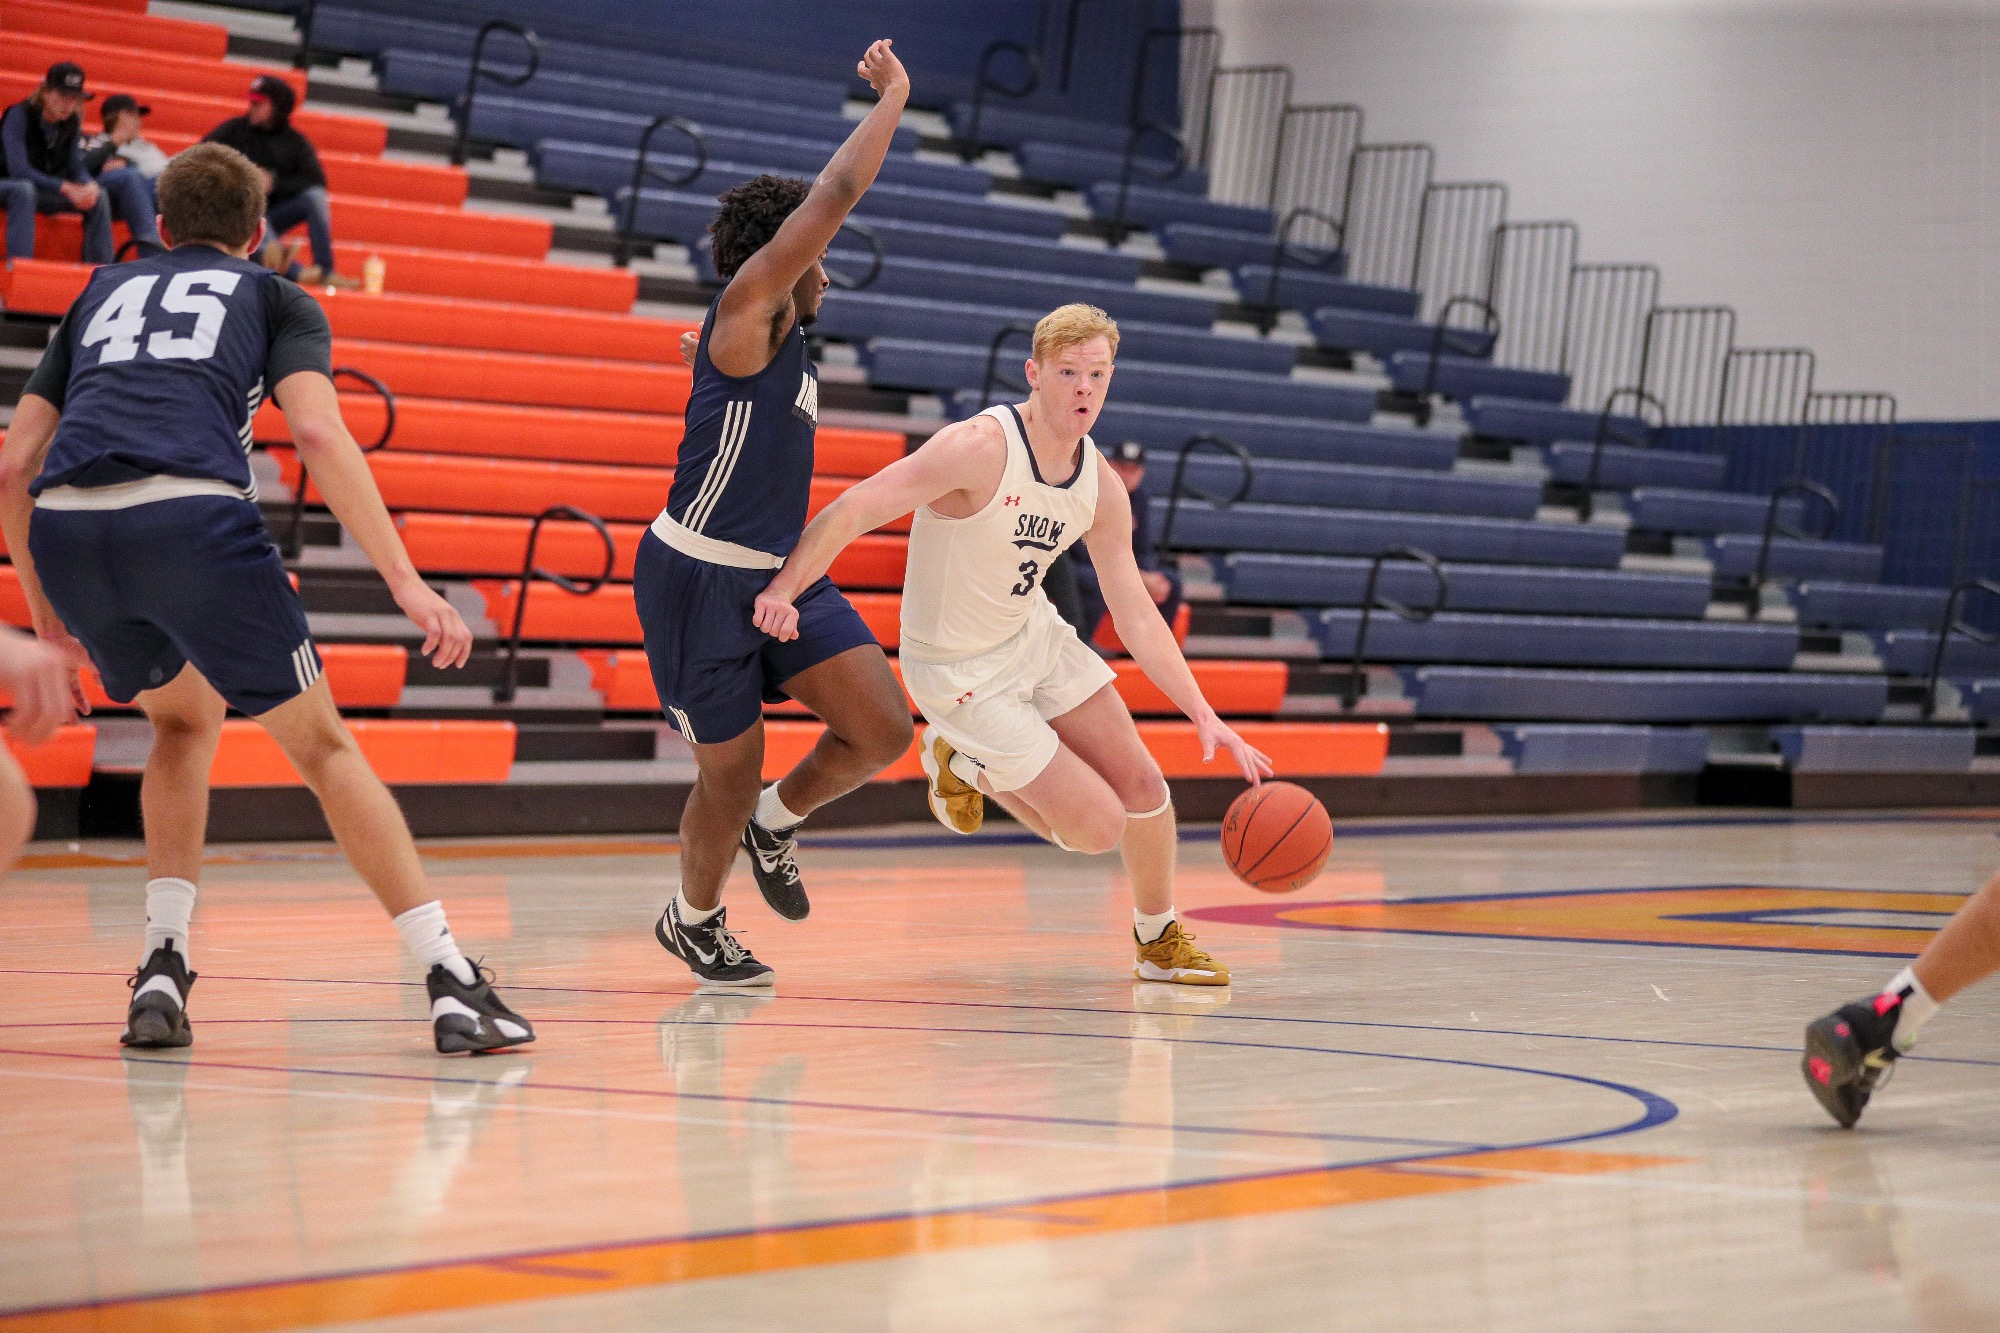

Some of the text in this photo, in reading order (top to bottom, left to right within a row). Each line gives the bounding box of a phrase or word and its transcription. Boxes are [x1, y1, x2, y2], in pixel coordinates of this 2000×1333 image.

[81, 269, 242, 365] 45
[1013, 513, 1066, 542] SNOW
[1010, 559, 1039, 597] 3
